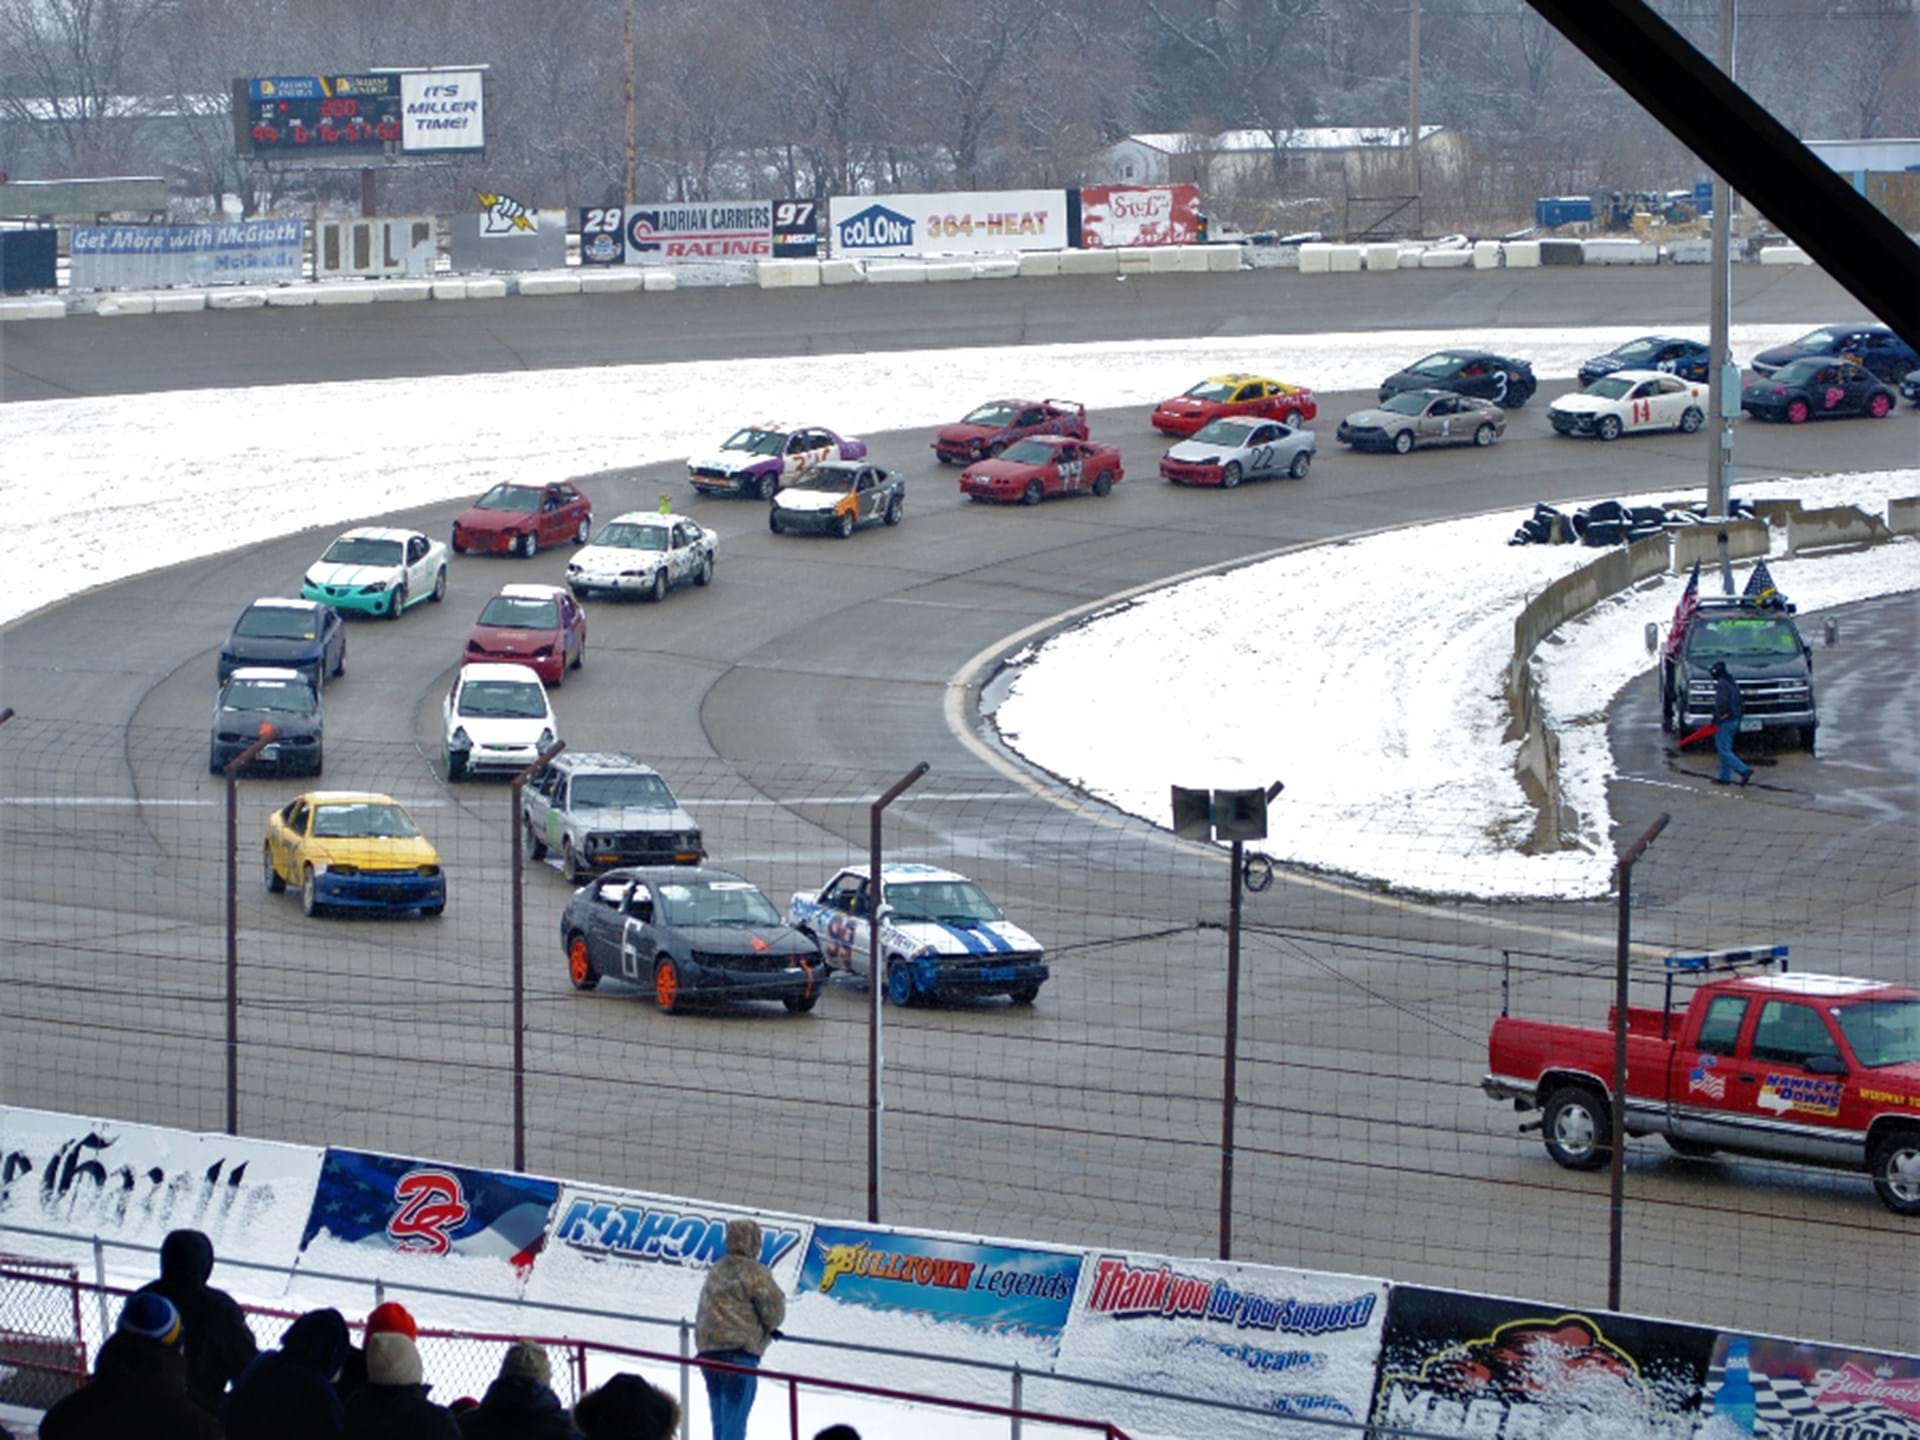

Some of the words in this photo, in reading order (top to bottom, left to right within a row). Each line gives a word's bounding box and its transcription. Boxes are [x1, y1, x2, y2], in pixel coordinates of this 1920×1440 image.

[406, 100, 478, 115] MILLER
[415, 117, 469, 130] TIME!
[584, 209, 621, 232] 29
[661, 209, 708, 231] ADRIAN
[711, 207, 769, 230] CARRIERS
[776, 203, 814, 226] 97
[926, 211, 1048, 239] 364-HEAT
[75, 231, 107, 249] Get
[111, 232, 164, 248] More
[170, 228, 212, 247] with
[218, 224, 297, 243] McGrath
[844, 214, 910, 246] COLONY
[666, 241, 769, 256] RACING
[1493, 371, 1507, 400] 3
[1632, 400, 1650, 424] 14
[1250, 445, 1275, 472] 22
[622, 916, 644, 978] 6
[1766, 1073, 1845, 1094] HAWKEYE
[556, 1198, 802, 1270] MAHONY
[974, 1263, 1073, 1301] Legends
[1090, 1258, 1172, 1313] Thank
[1163, 1277, 1211, 1316] you
[1210, 1280, 1241, 1318] for
[1238, 1294, 1282, 1325] your
[1280, 1293, 1376, 1332] Support!
